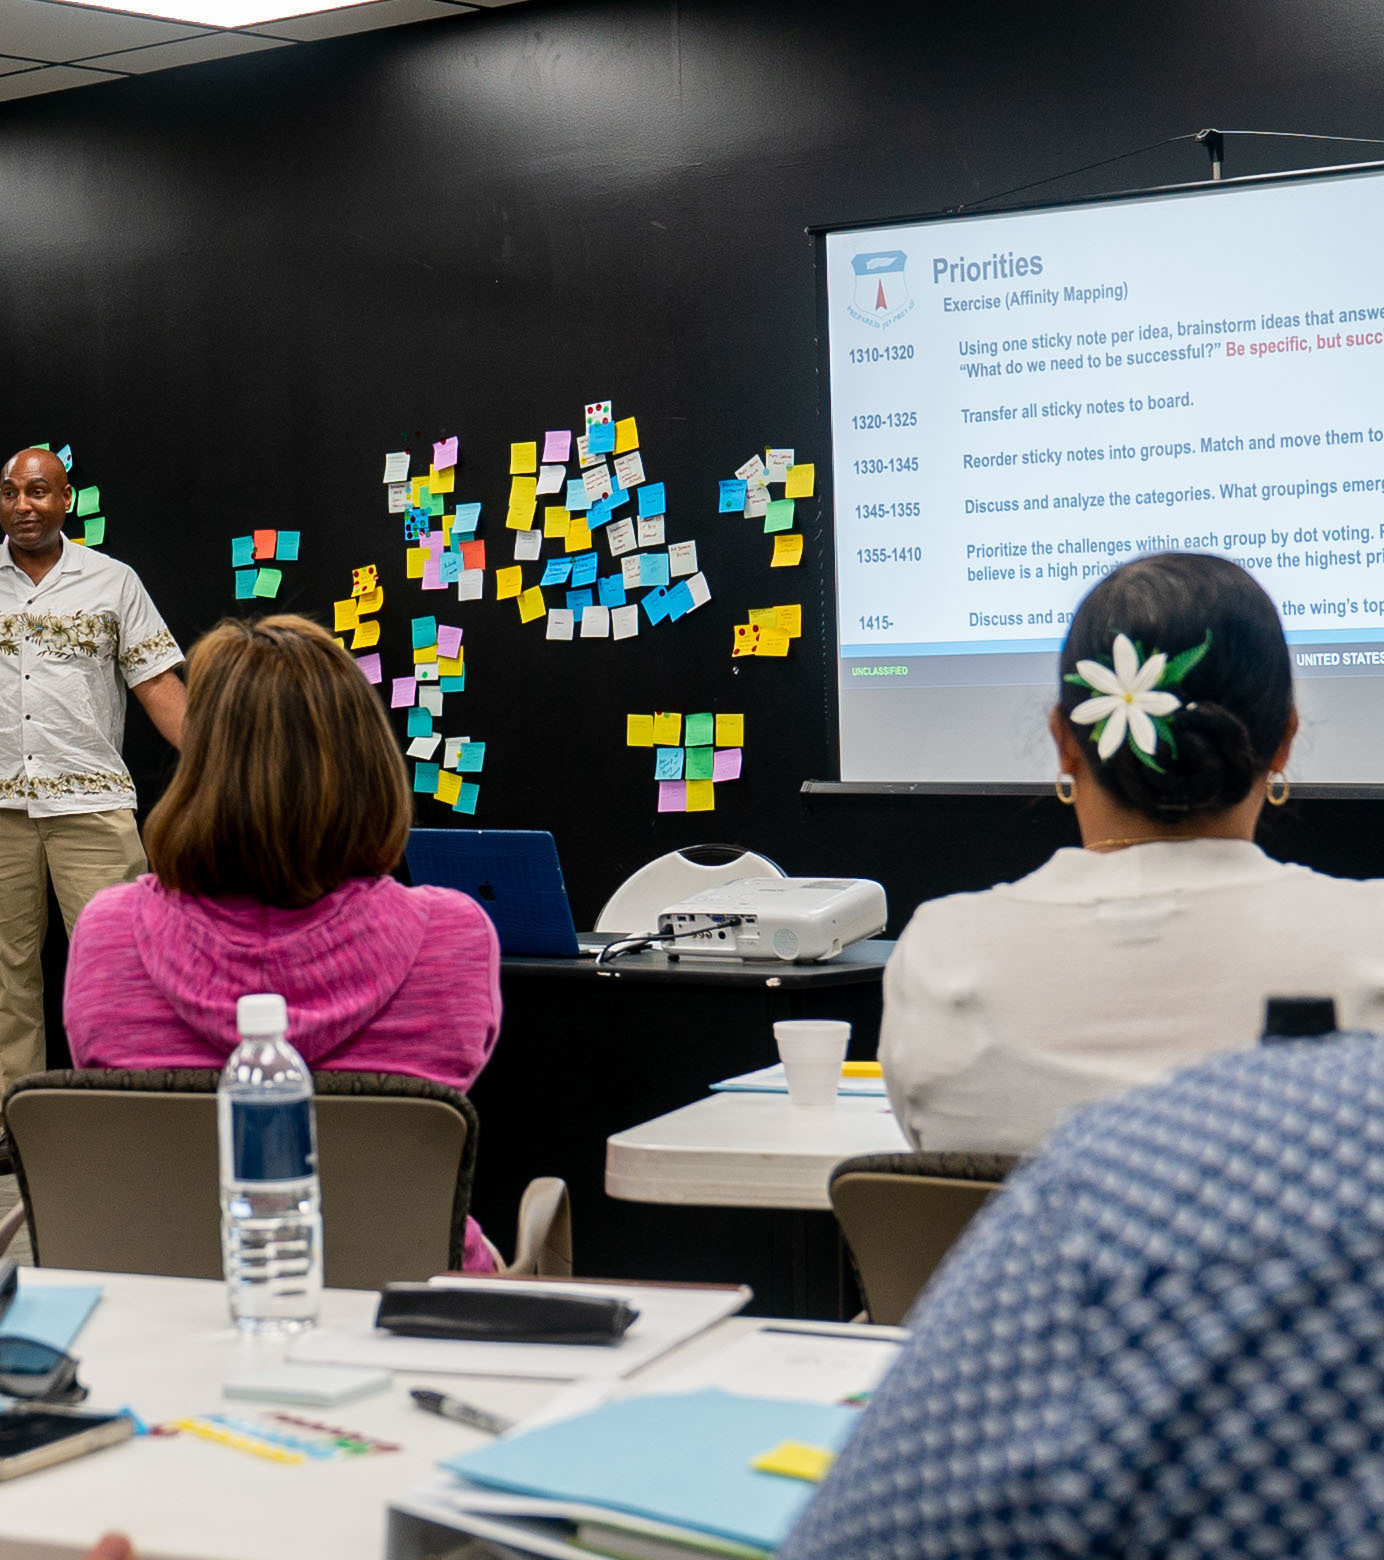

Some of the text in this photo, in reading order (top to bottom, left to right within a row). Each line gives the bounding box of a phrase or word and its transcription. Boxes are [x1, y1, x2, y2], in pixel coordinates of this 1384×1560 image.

[933, 252, 1043, 283] Priorities
[943, 281, 1128, 312] Exercise (Affinity Mapping)
[959, 340, 998, 357] Using
[1002, 338, 1027, 352] one
[1032, 332, 1072, 350] sticky
[1077, 330, 1107, 346] note
[1111, 328, 1134, 347] per
[1138, 324, 1173, 341] idea,
[1178, 318, 1256, 337] brainstorm
[1261, 313, 1300, 330] ideas
[1305, 309, 1335, 326] that
[849, 344, 914, 364] 1310-1320
[1006, 360, 1023, 375] do
[1027, 359, 1046, 373] we
[1050, 354, 1083, 371] need
[1087, 354, 1101, 369] to
[1106, 352, 1123, 368] be
[1226, 341, 1245, 357] Be
[1249, 336, 1312, 358] specific,
[1316, 333, 1342, 350] but
[1346, 329, 1384, 347] succ
[852, 411, 917, 430] 1320-1325
[961, 391, 1194, 423] Transfer all sticky notes to board.
[963, 427, 1384, 469] Reorder sticky notes into groups. Match and move them to
[853, 456, 919, 475] 1330-1345
[855, 502, 920, 520] 1345-1355
[965, 498, 1019, 514] Discuss
[1023, 494, 1049, 511] and
[1053, 493, 1105, 511] analyze
[1109, 491, 1131, 507] the
[1135, 485, 1216, 507] categories.
[1219, 482, 1257, 499] What
[1261, 479, 1338, 501] groupings
[857, 546, 922, 564] 1355-1410
[967, 542, 1027, 559] Prioritize
[1031, 540, 1053, 555] the
[1057, 537, 1132, 556] challenges
[1135, 535, 1179, 551] within
[1184, 531, 1218, 548] each
[1223, 532, 1266, 550] group
[1271, 529, 1289, 547] by
[1293, 527, 1317, 543] dot
[1322, 525, 1375, 543] voting.
[967, 566, 1015, 582] believe
[1019, 564, 1031, 579] is
[1036, 567, 1043, 579] a
[1047, 563, 1078, 581] high
[1277, 553, 1301, 568] the
[1305, 550, 1362, 570] highest
[859, 615, 894, 630] 1415-
[969, 611, 1023, 627] Discuss
[1027, 609, 1053, 625] and
[1282, 600, 1306, 616] the
[1310, 598, 1359, 618] wing’s
[851, 666, 909, 676] UNCLASSIFIED
[1296, 651, 1384, 667] UNITED STATES
